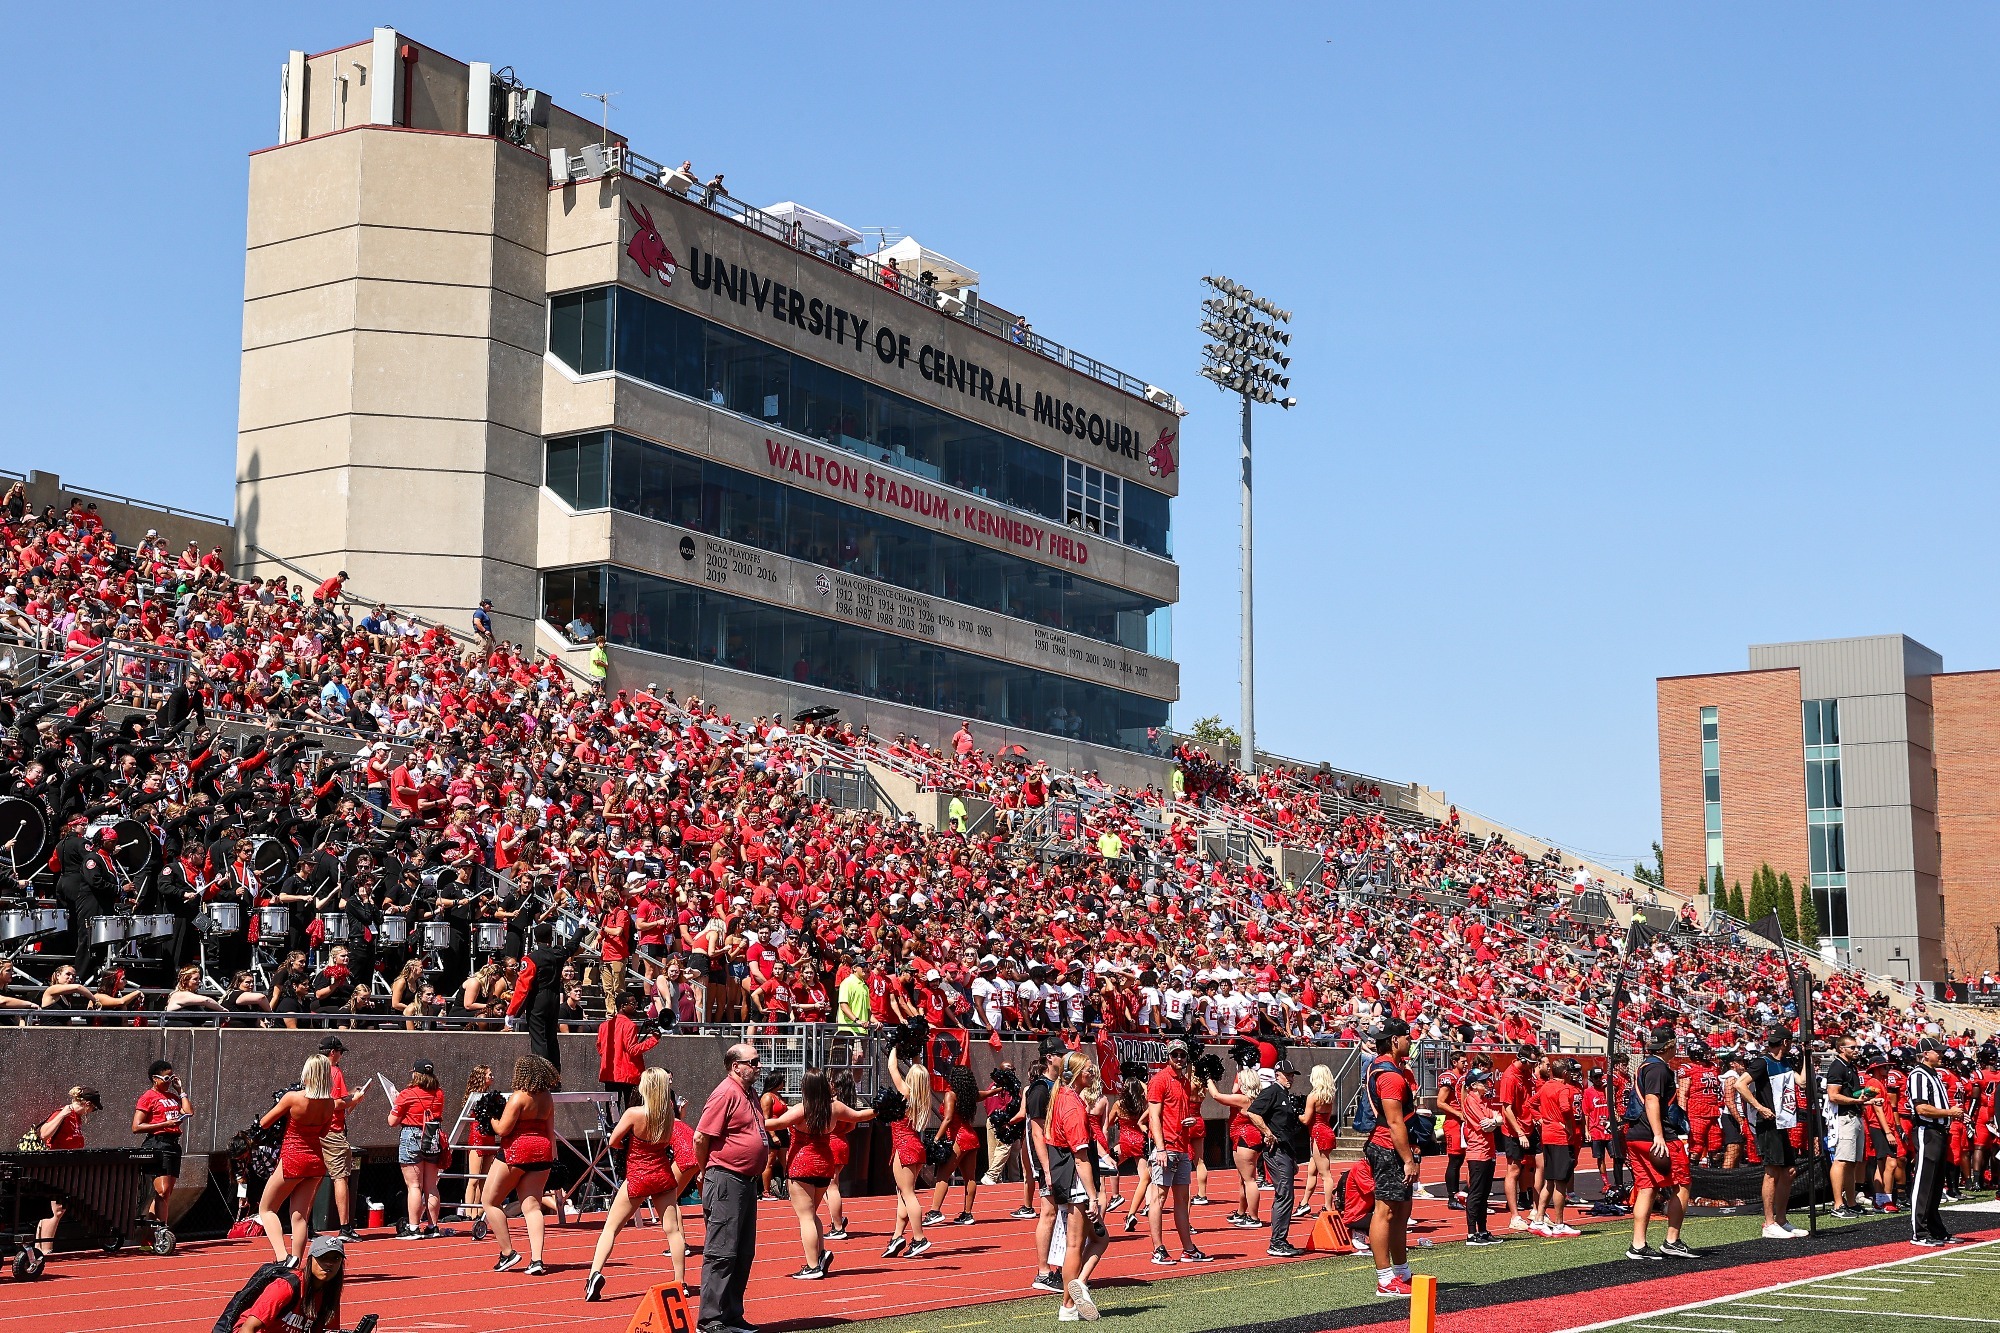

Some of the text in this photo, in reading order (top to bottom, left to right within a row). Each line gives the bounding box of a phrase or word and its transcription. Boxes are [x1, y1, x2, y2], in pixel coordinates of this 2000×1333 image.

[690, 247, 1141, 462] UNIVERSITY OF CENTRAL MISSOURI
[765, 438, 1088, 565] WALTON STADIUM KENNEDY FIELD
[706, 542, 761, 564] NCAA PLAYOFFS
[706, 553, 777, 583] 2002 2010 2016
[706, 568, 727, 584] 2019
[835, 575, 930, 609] MIAA CONFERENCE CHAMPIONS
[835, 587, 993, 638] 1912 1913 1914 1915 1926 1956 1970 1983
[835, 601, 935, 636] 1986 1987 1988 2003 2019
[1034, 629, 1067, 645] BOWL GAMES
[1034, 639, 1148, 678] 1950 1968 1970 2001 2011 2014 2017
[1171, 999, 1180, 1014] 8
[1114, 1036, 1168, 1064] ROARING
[1327, 1214, 1351, 1247] 10
[661, 1287, 690, 1333] G
